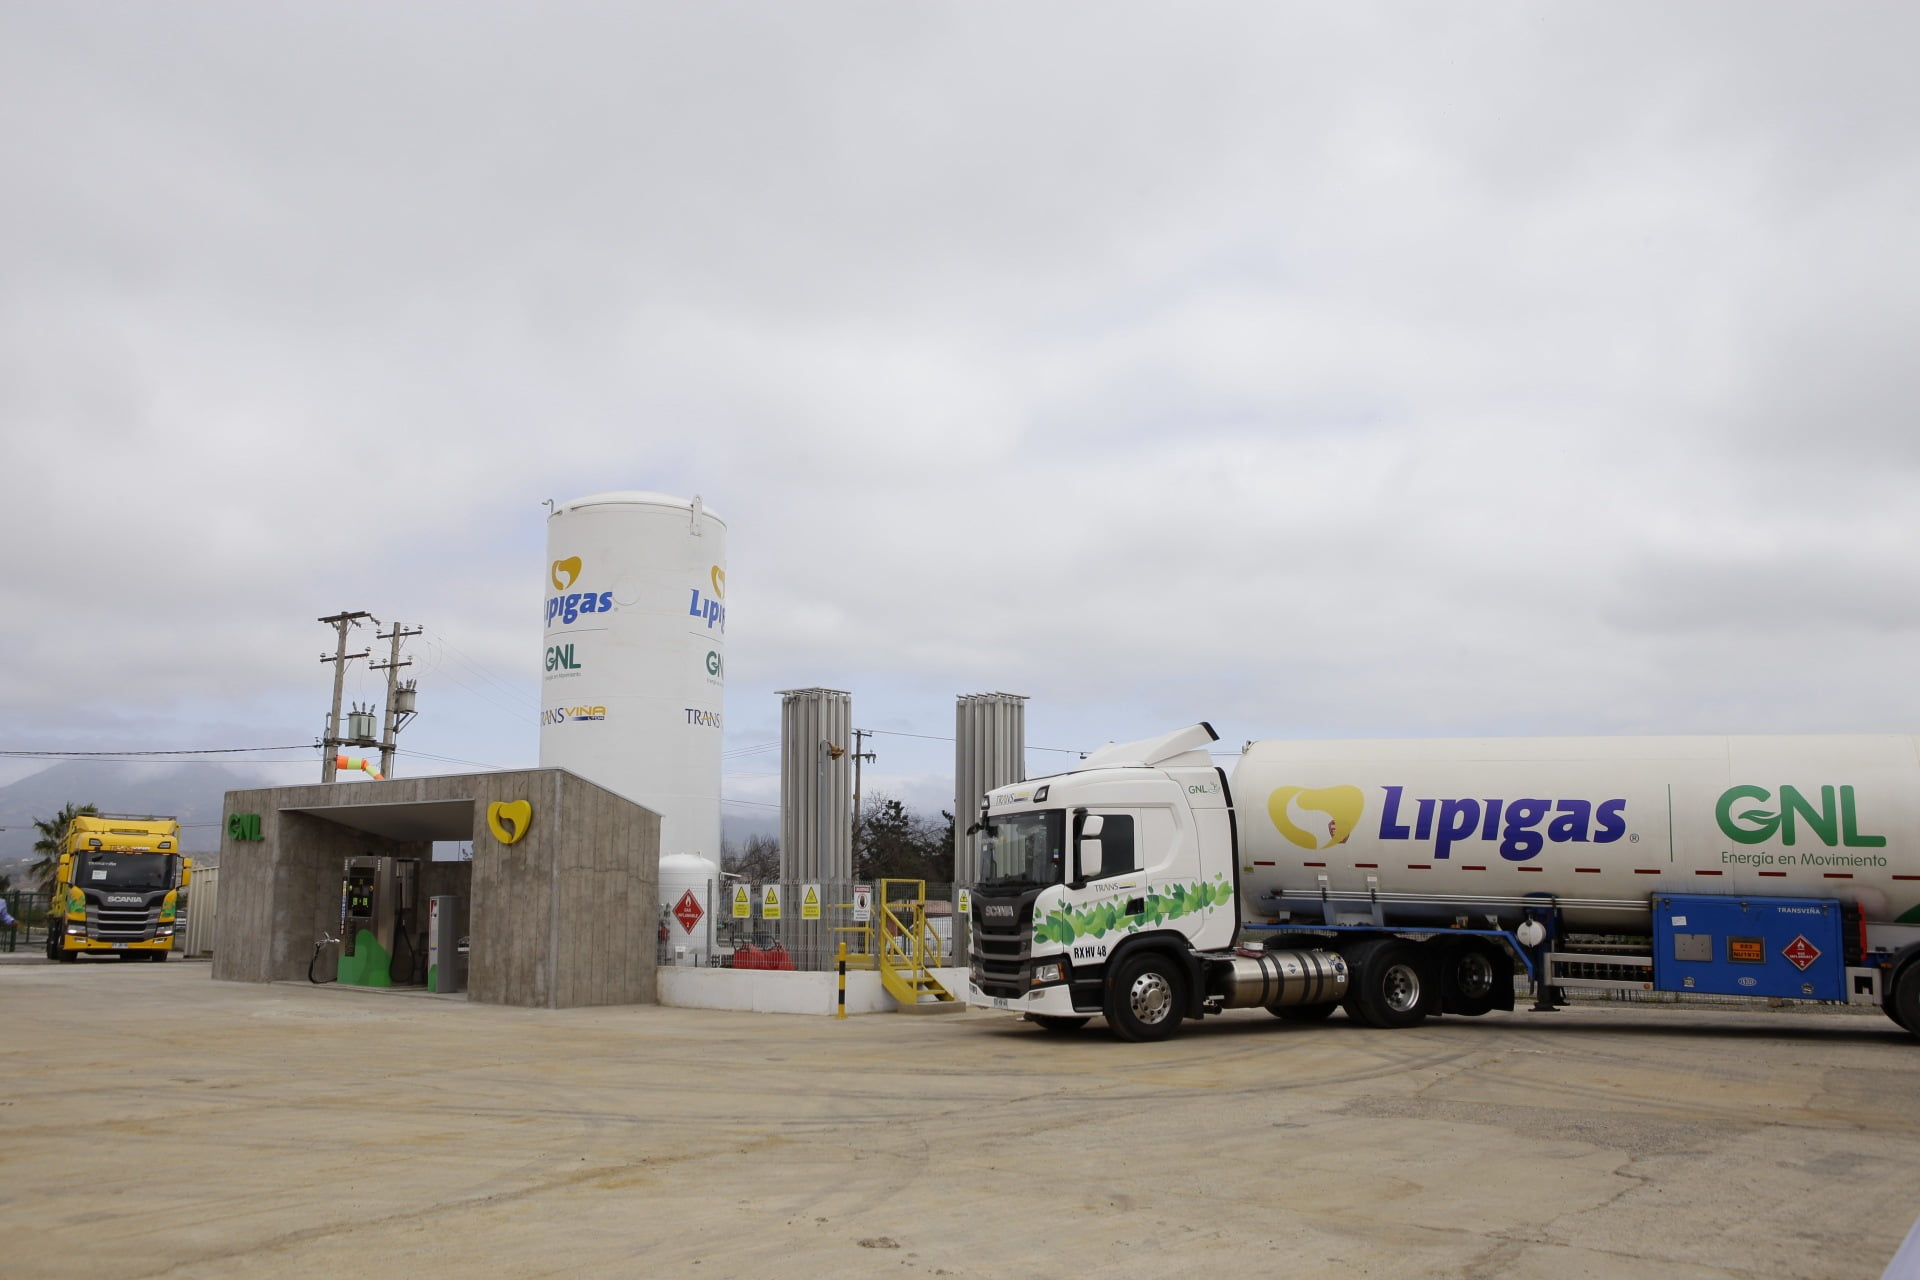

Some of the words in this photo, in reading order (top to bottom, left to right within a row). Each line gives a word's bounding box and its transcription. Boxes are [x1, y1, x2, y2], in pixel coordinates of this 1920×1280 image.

[544, 592, 613, 628] ipigas
[545, 643, 582, 672] GNL
[706, 650, 724, 681] GN
[1188, 785, 1208, 795] GNL
[228, 813, 265, 842] GNL
[1378, 785, 1627, 861] Lipigas
[1715, 784, 1887, 848] GNL
[1721, 851, 1774, 867] Energía
[1778, 854, 1796, 865] en
[1800, 853, 1888, 867] Movimiento
[107, 895, 143, 903] SCANIA
[985, 905, 1014, 917] SCANIA
[1097, 945, 1108, 957] 48
